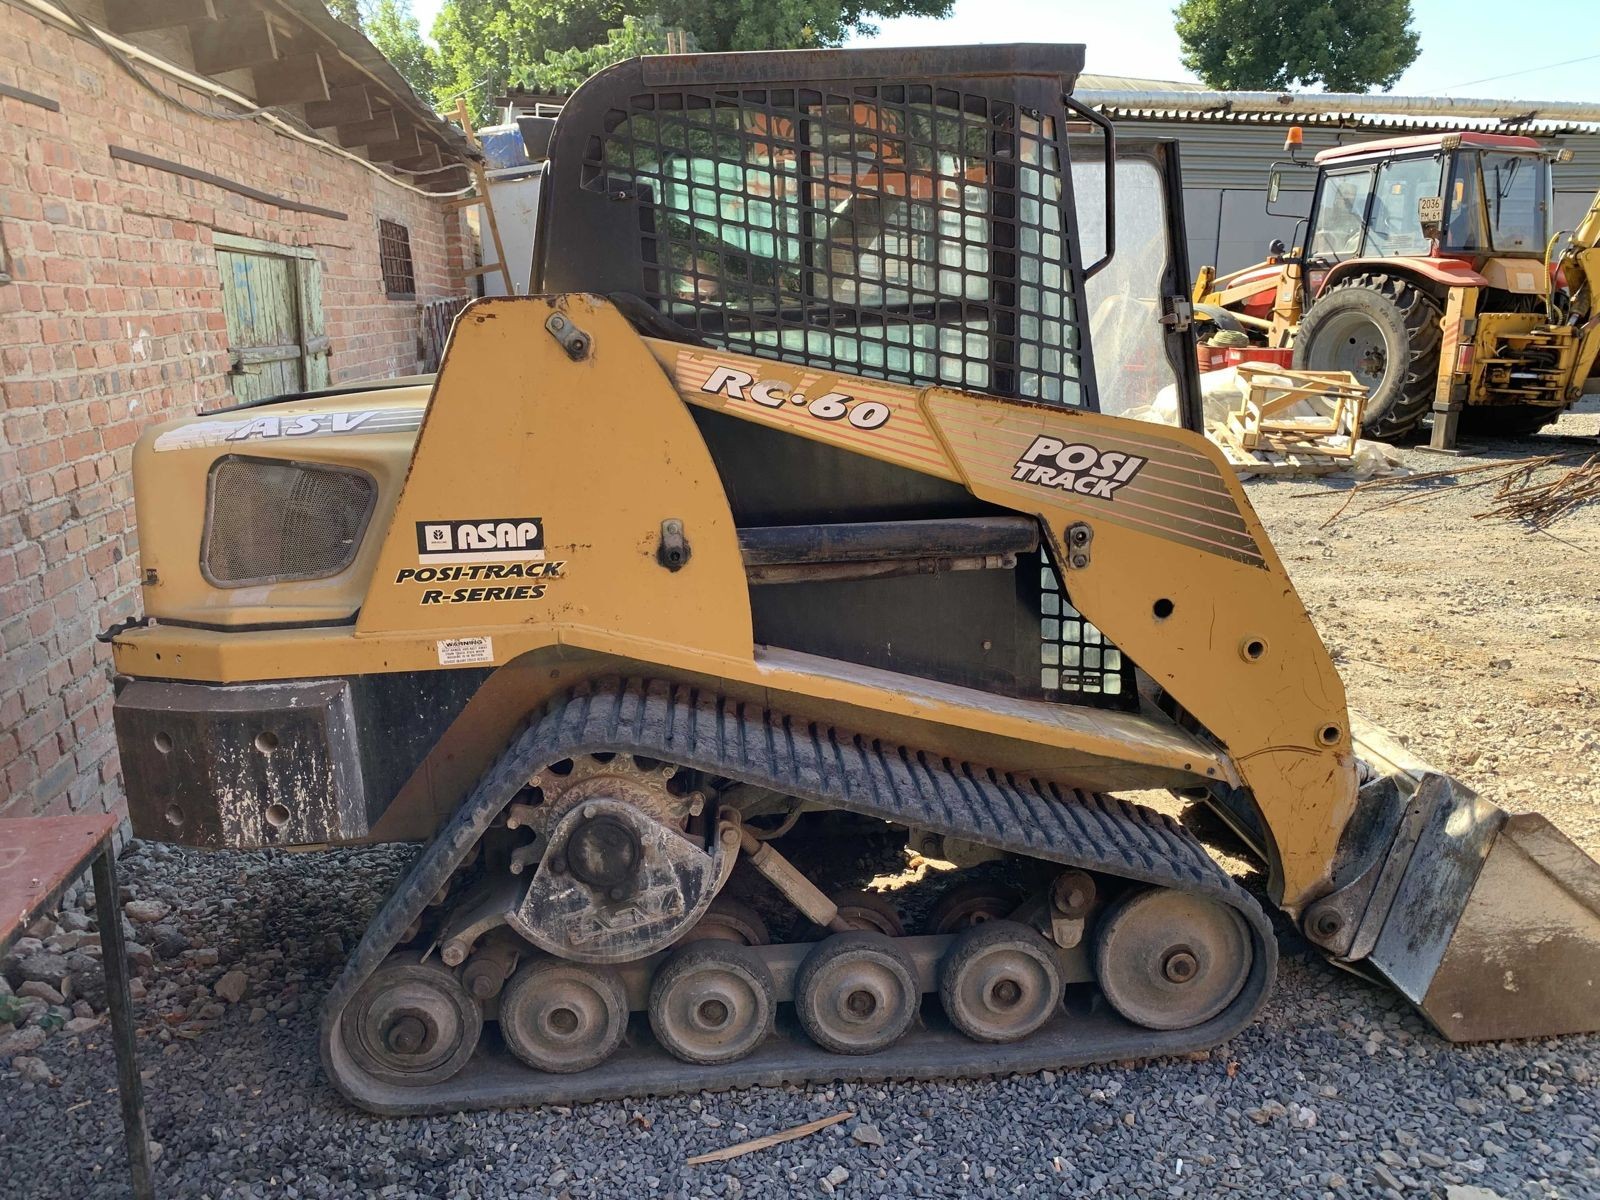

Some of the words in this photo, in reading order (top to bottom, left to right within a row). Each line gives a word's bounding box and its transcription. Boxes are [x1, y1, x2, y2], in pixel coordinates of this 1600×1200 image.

[1421, 199, 1440, 209] 2036
[1432, 211, 1440, 220] 61
[225, 411, 378, 441] ASV
[1021, 435, 1144, 482] POSI
[1012, 461, 1121, 498] TRACK
[457, 522, 538, 550] ASAP
[395, 561, 565, 584] POSI-TRACK
[421, 585, 547, 605] R-SERIES
[446, 639, 483, 647] WARNING
